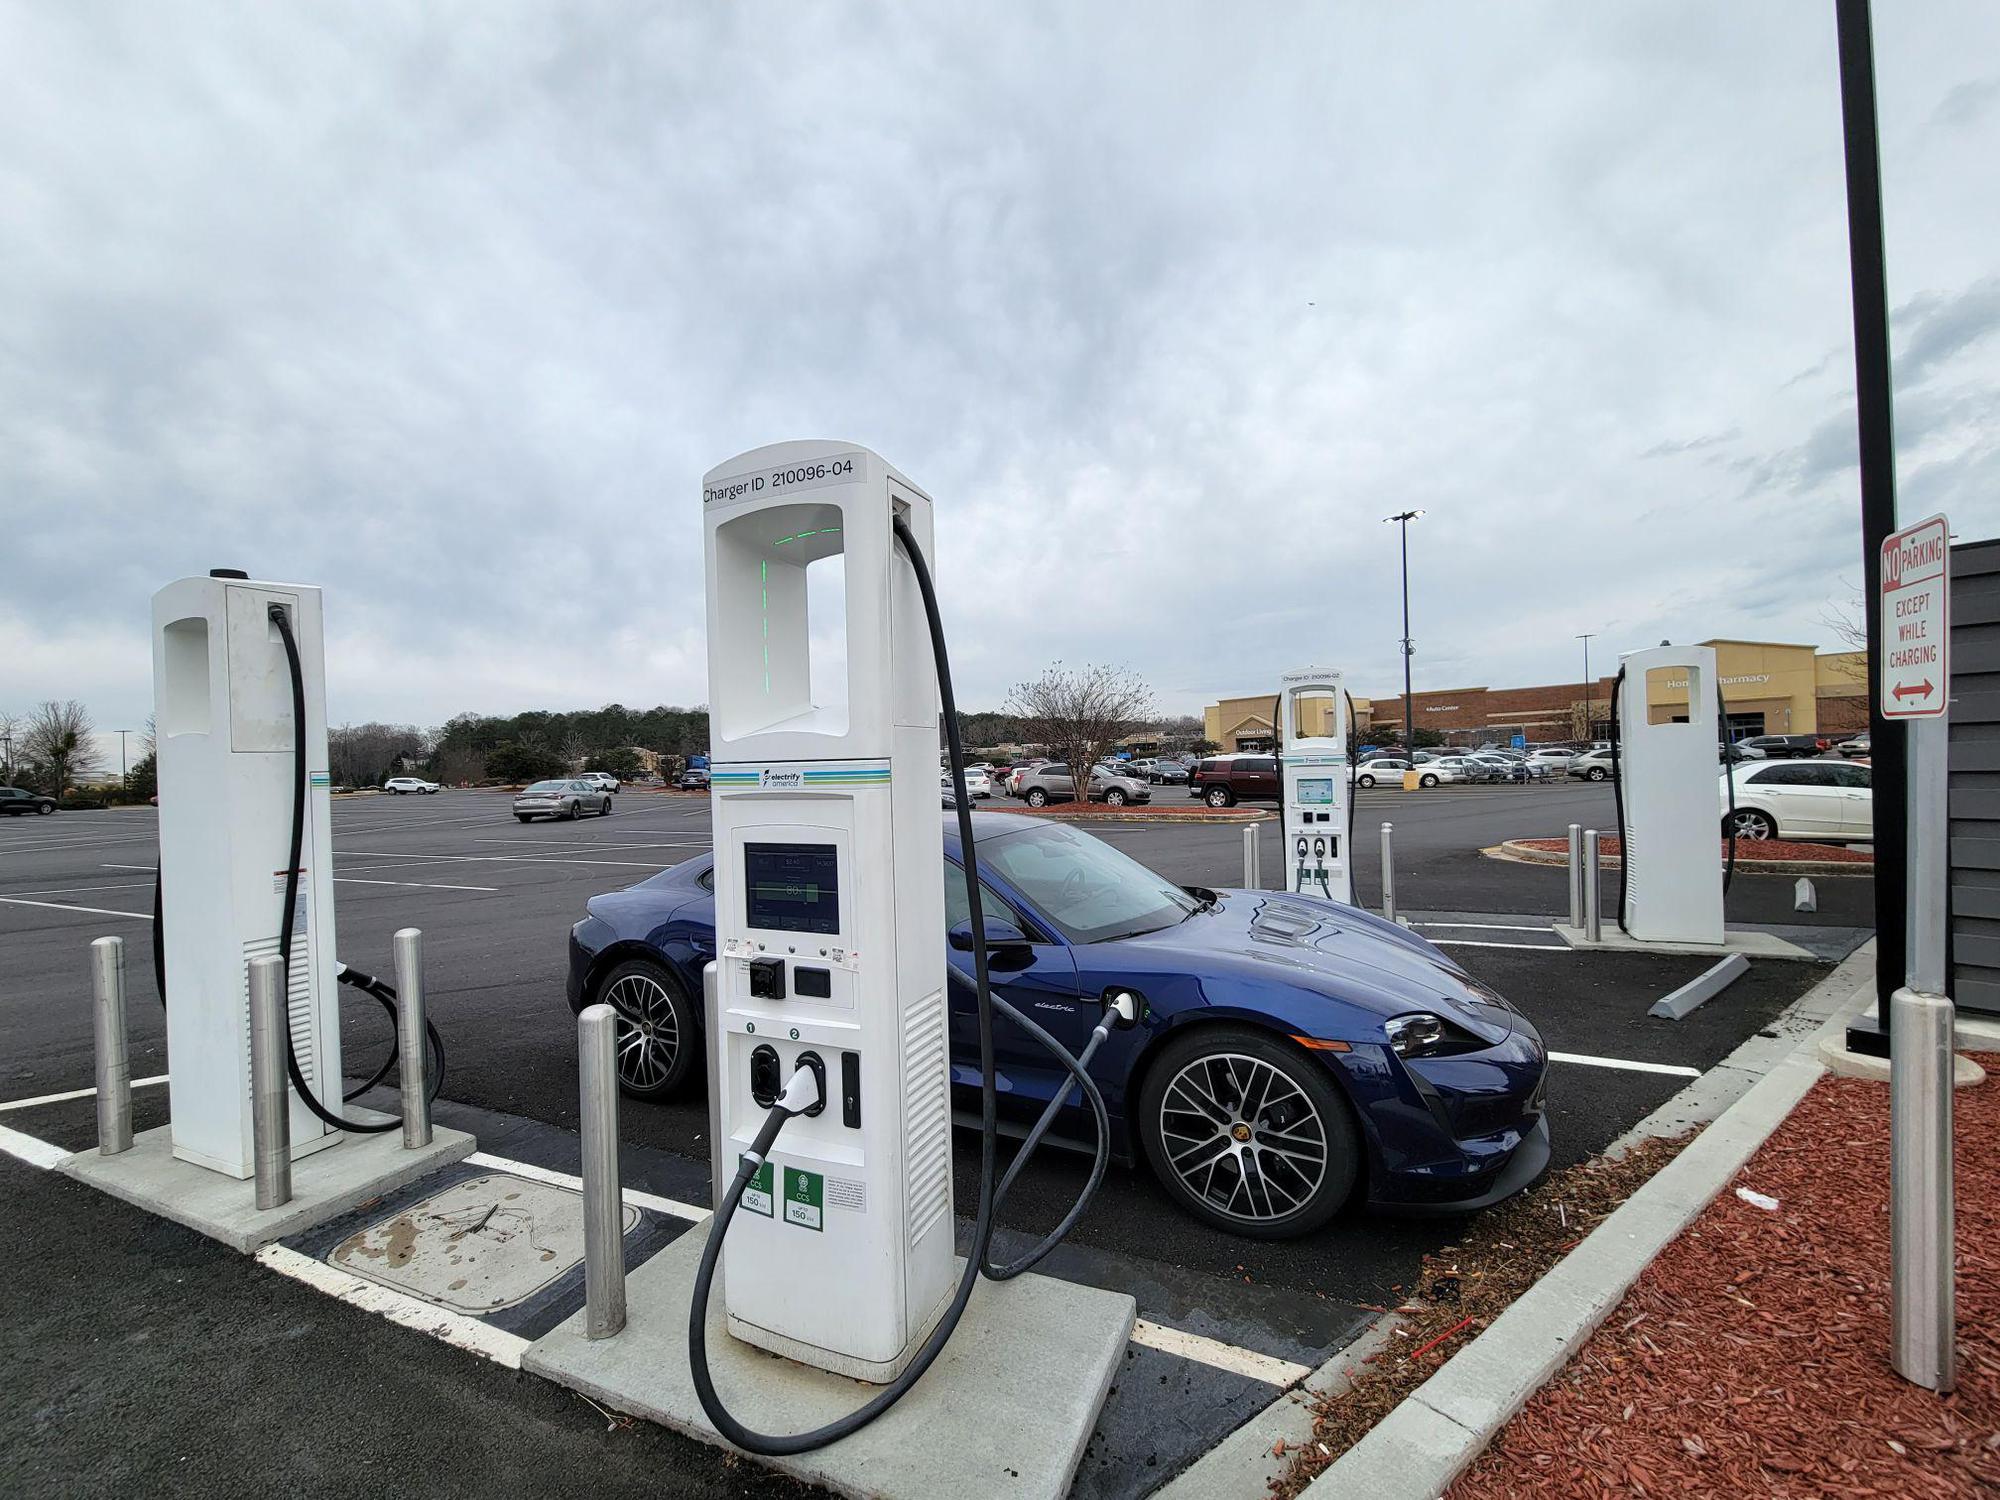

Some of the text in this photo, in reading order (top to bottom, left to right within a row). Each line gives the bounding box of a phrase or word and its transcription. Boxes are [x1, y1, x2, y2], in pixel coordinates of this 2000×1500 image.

[703, 460, 853, 503] Charger ID 210096-04
[1883, 536, 1942, 584] NO PARKING
[1896, 593, 1930, 618] EXCEPT
[1898, 620, 1927, 642] WHILE
[1890, 645, 1937, 668] CHARGING
[1719, 673, 1770, 685] harmacy
[1256, 728, 1272, 736] Living
[771, 773, 800, 781] electrify
[1034, 1002, 1075, 1012] electric
[750, 1180, 762, 1189] CCS
[746, 1196, 759, 1206] 150
[796, 1193, 810, 1202] CCS
[792, 1209, 806, 1220] 150
